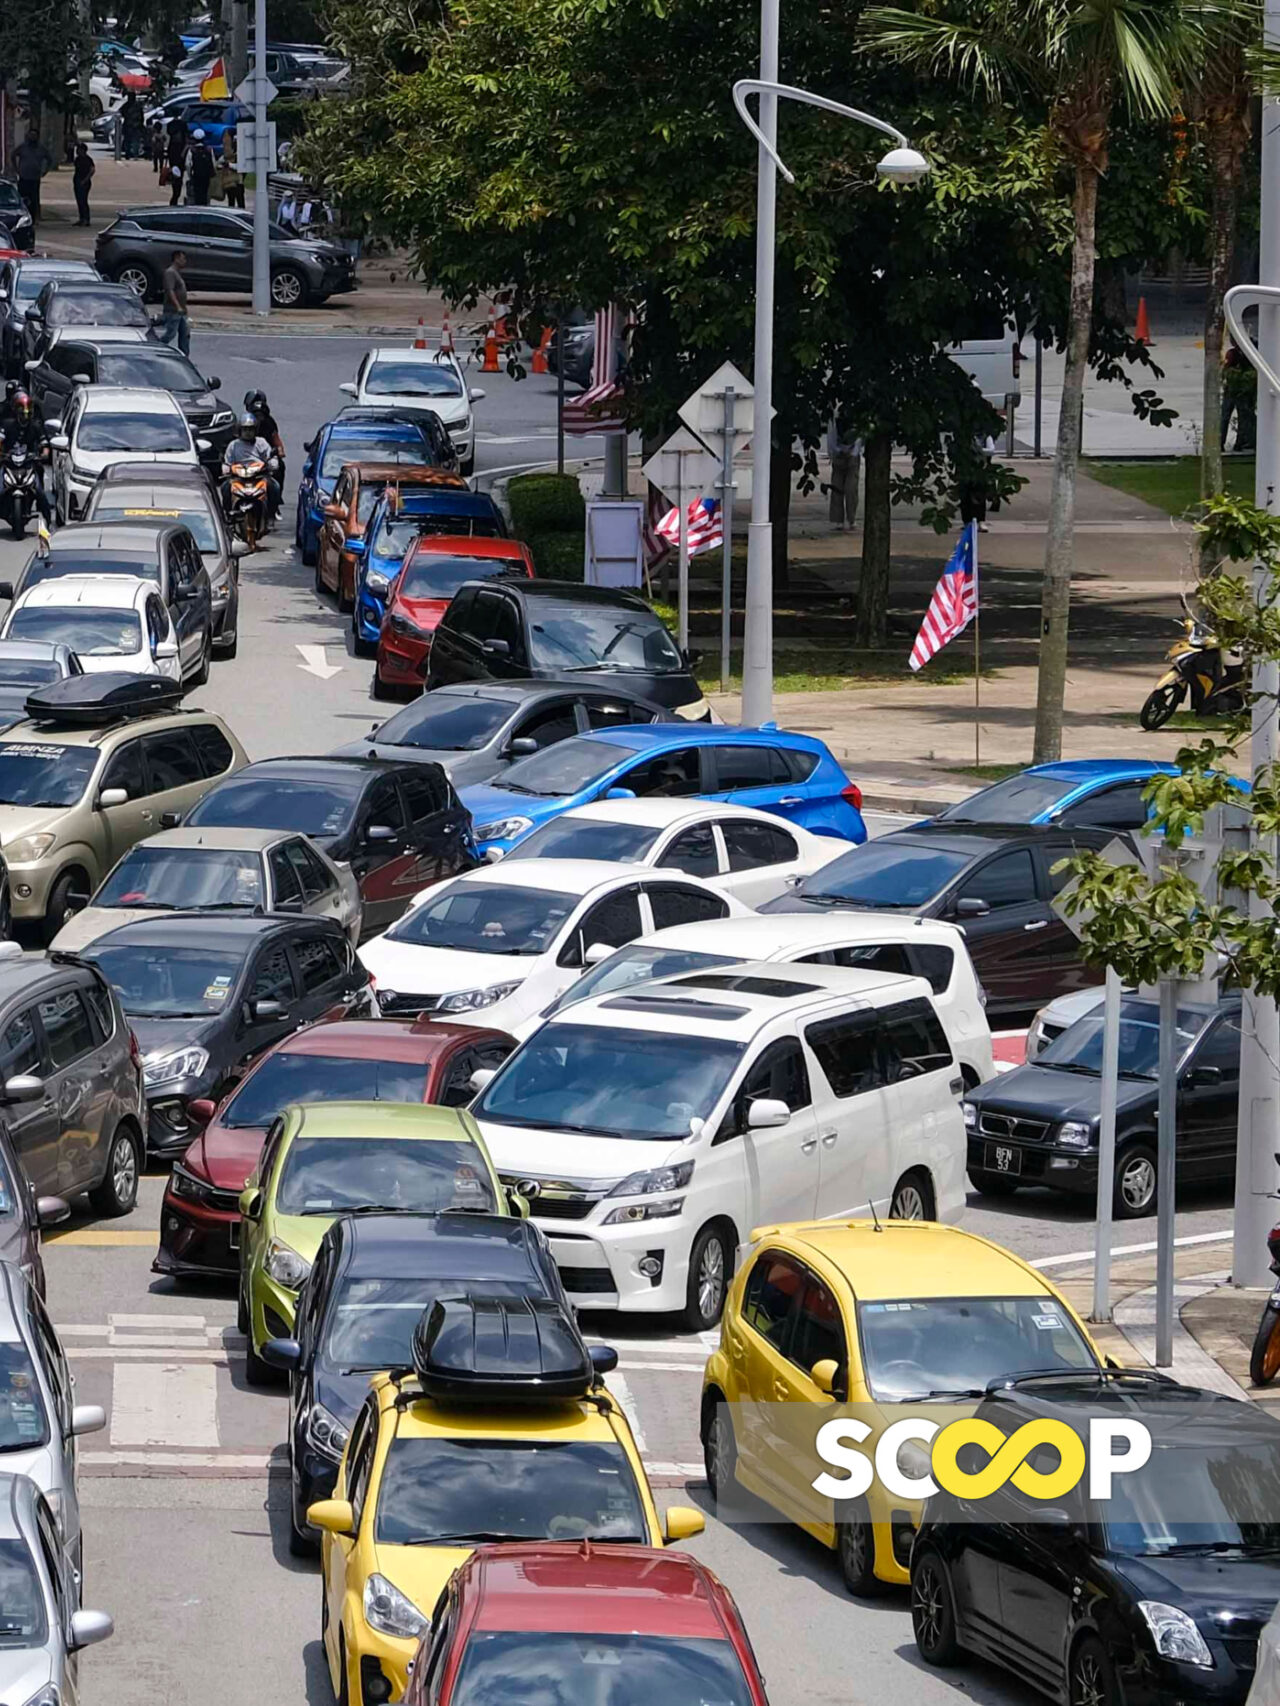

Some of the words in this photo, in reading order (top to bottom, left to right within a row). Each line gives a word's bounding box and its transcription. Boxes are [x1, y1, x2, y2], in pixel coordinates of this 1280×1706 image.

[2, 744, 67, 755] AVANZA
[996, 1146, 1012, 1161] BFN
[997, 1159, 1009, 1171] 53
